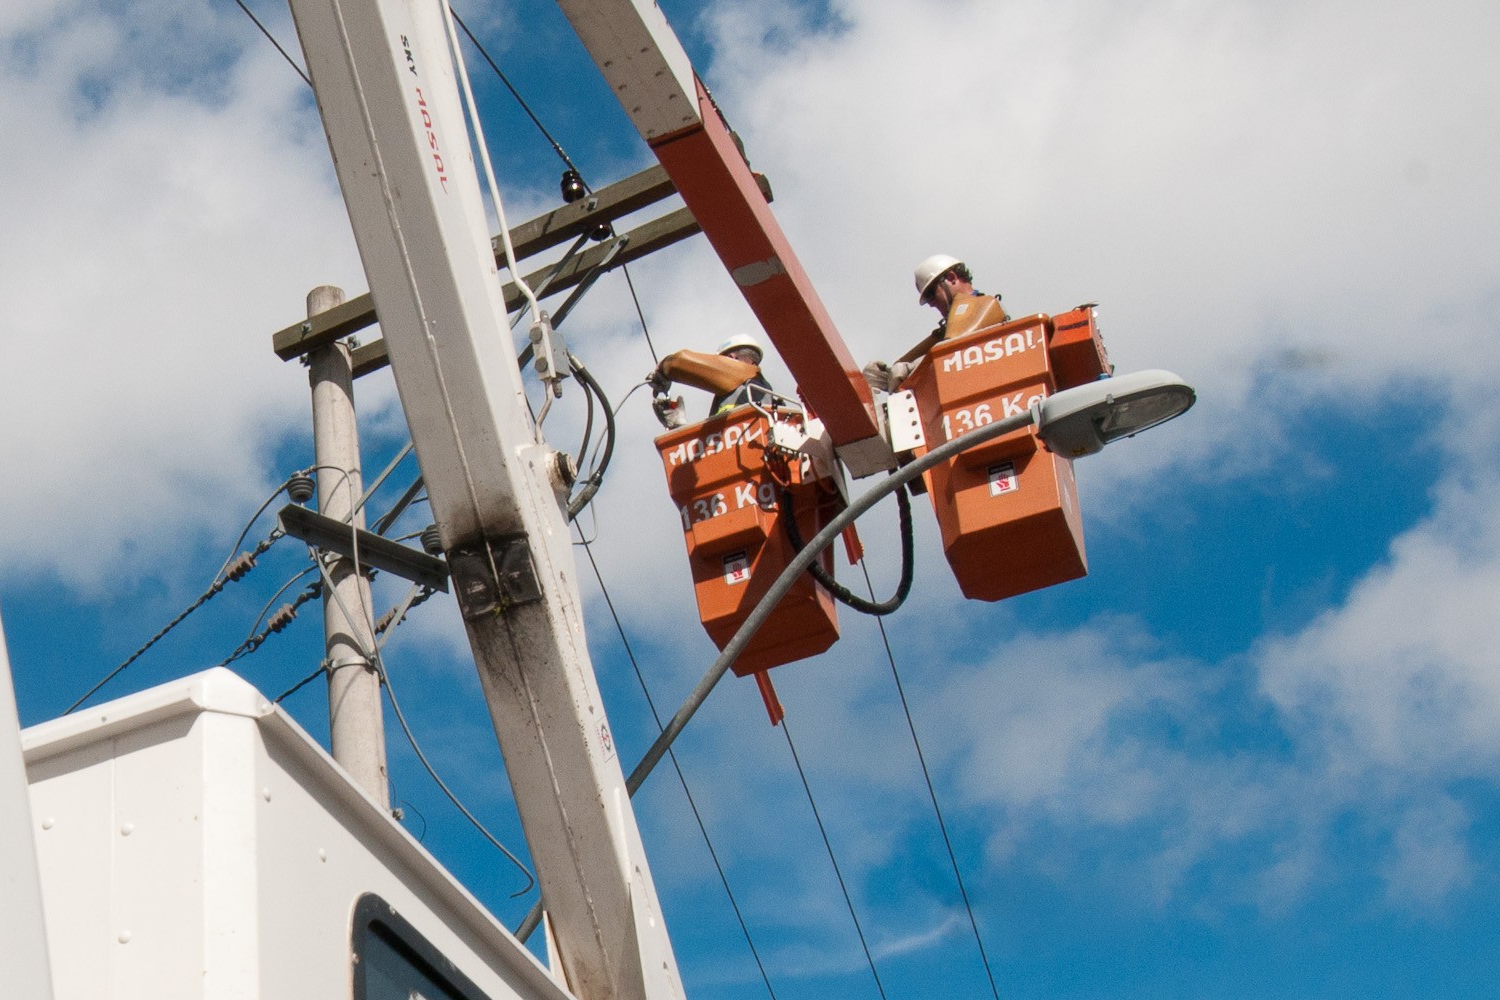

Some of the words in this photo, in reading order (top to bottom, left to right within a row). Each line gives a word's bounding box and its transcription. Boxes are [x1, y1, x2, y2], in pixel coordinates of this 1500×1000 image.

[400, 34, 418, 76] SKY
[416, 87, 448, 195] MASAL
[669, 422, 763, 466] MASAL
[941, 403, 993, 441] 136
[680, 492, 728, 531] 136
[735, 481, 778, 512] Kg
